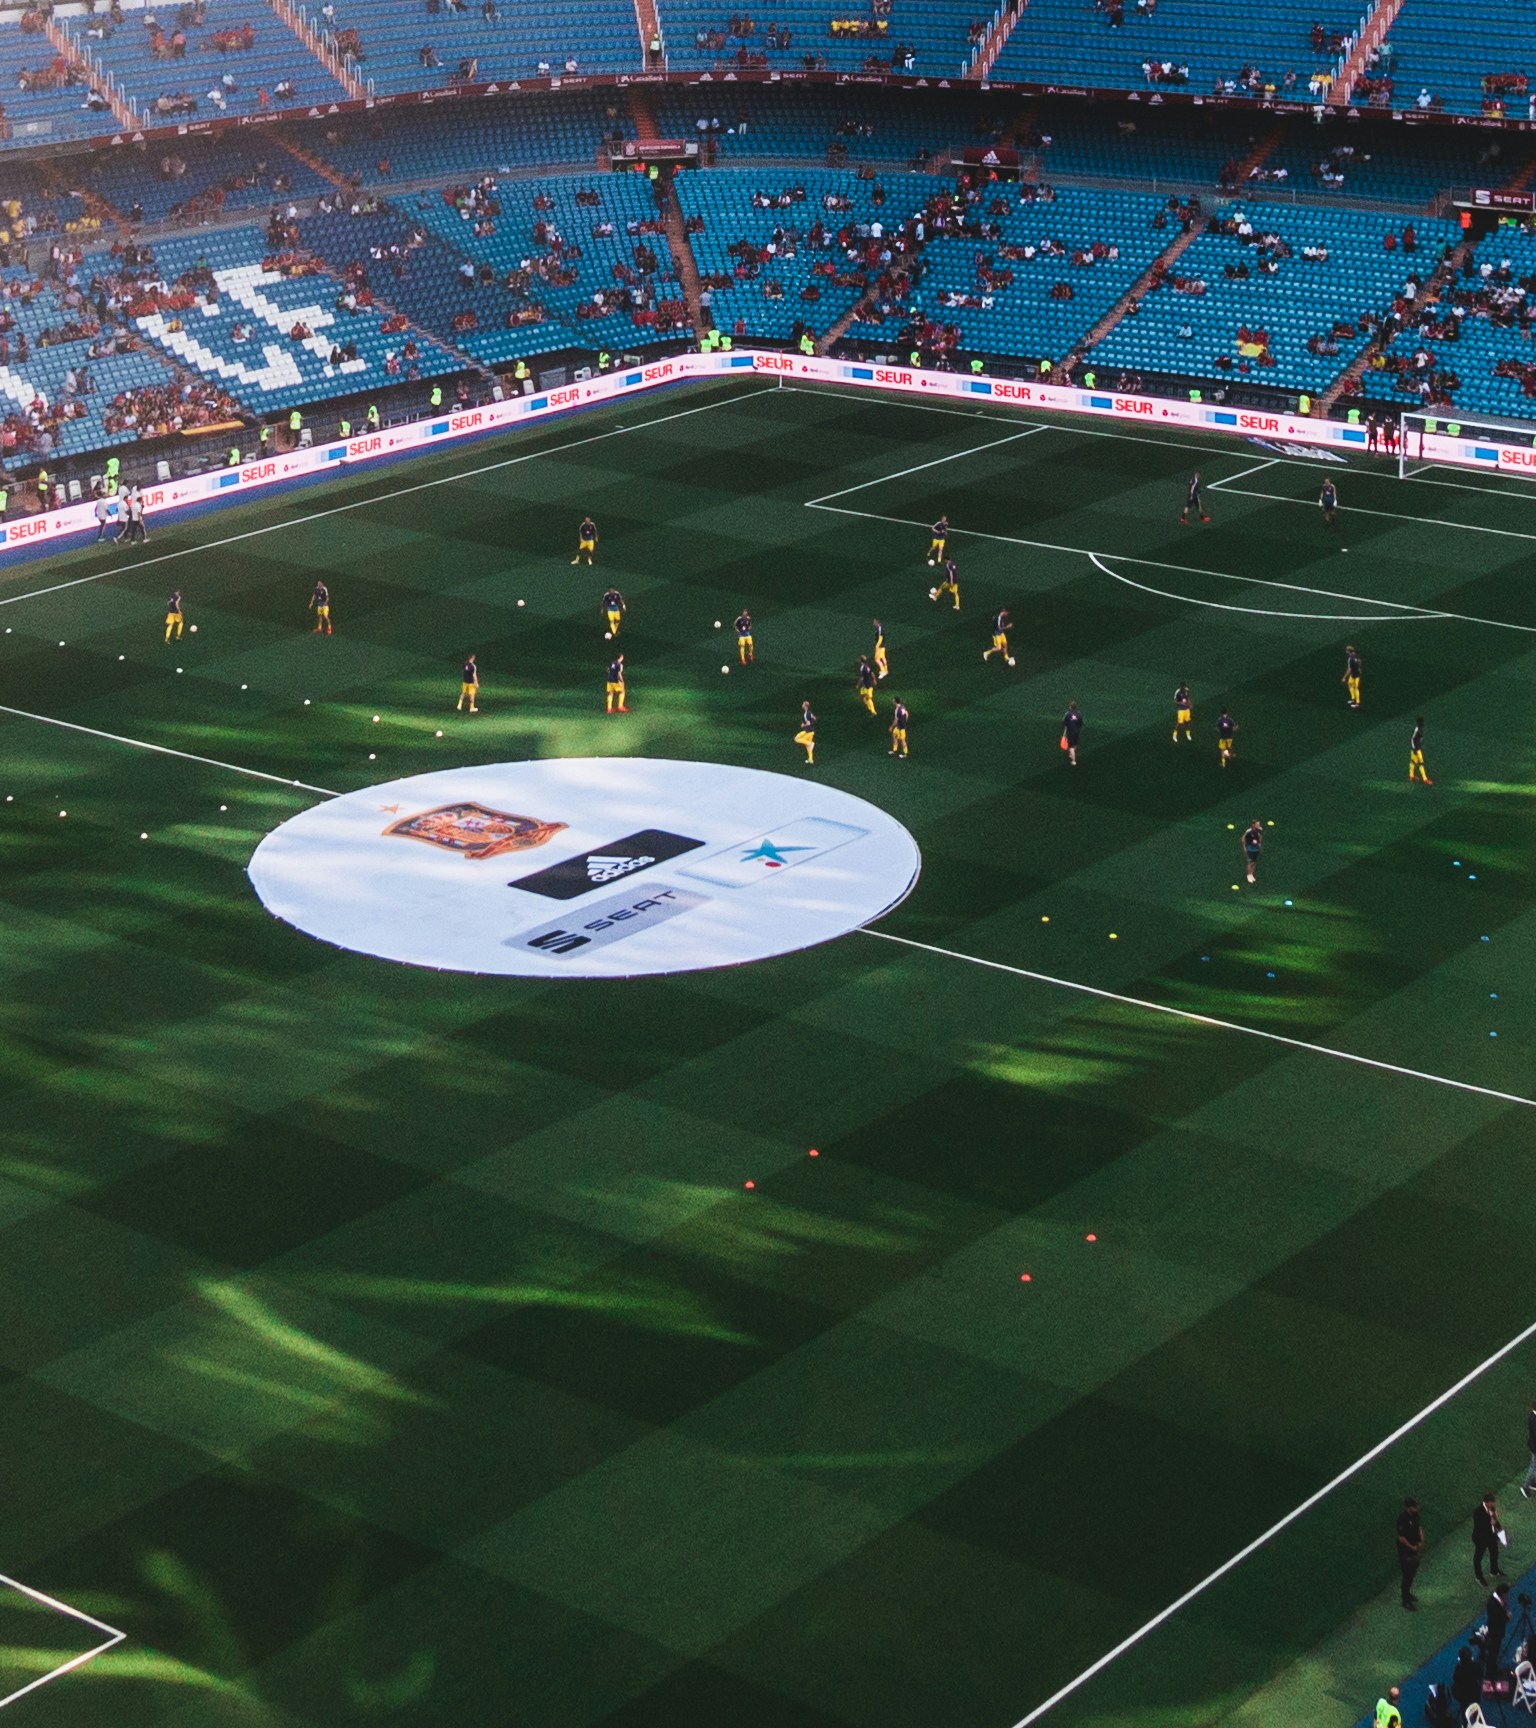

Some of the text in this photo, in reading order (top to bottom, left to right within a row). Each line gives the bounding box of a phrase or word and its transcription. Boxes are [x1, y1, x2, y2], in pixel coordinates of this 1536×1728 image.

[1494, 194, 1531, 205] SEAT
[756, 356, 793, 371] SEUR
[644, 364, 673, 381] SEUR
[876, 370, 912, 385] SEUR
[550, 388, 580, 406] SEUR
[994, 384, 1031, 399] SEUR
[1115, 399, 1153, 415] SEUR
[452, 413, 482, 431] SEUR
[1239, 415, 1279, 432] SEUR
[349, 437, 381, 456] SEUR
[242, 463, 275, 483] SEUR
[128, 491, 164, 509] EUR
[9, 519, 47, 541] SEUR
[584, 890, 676, 932] SEAT
